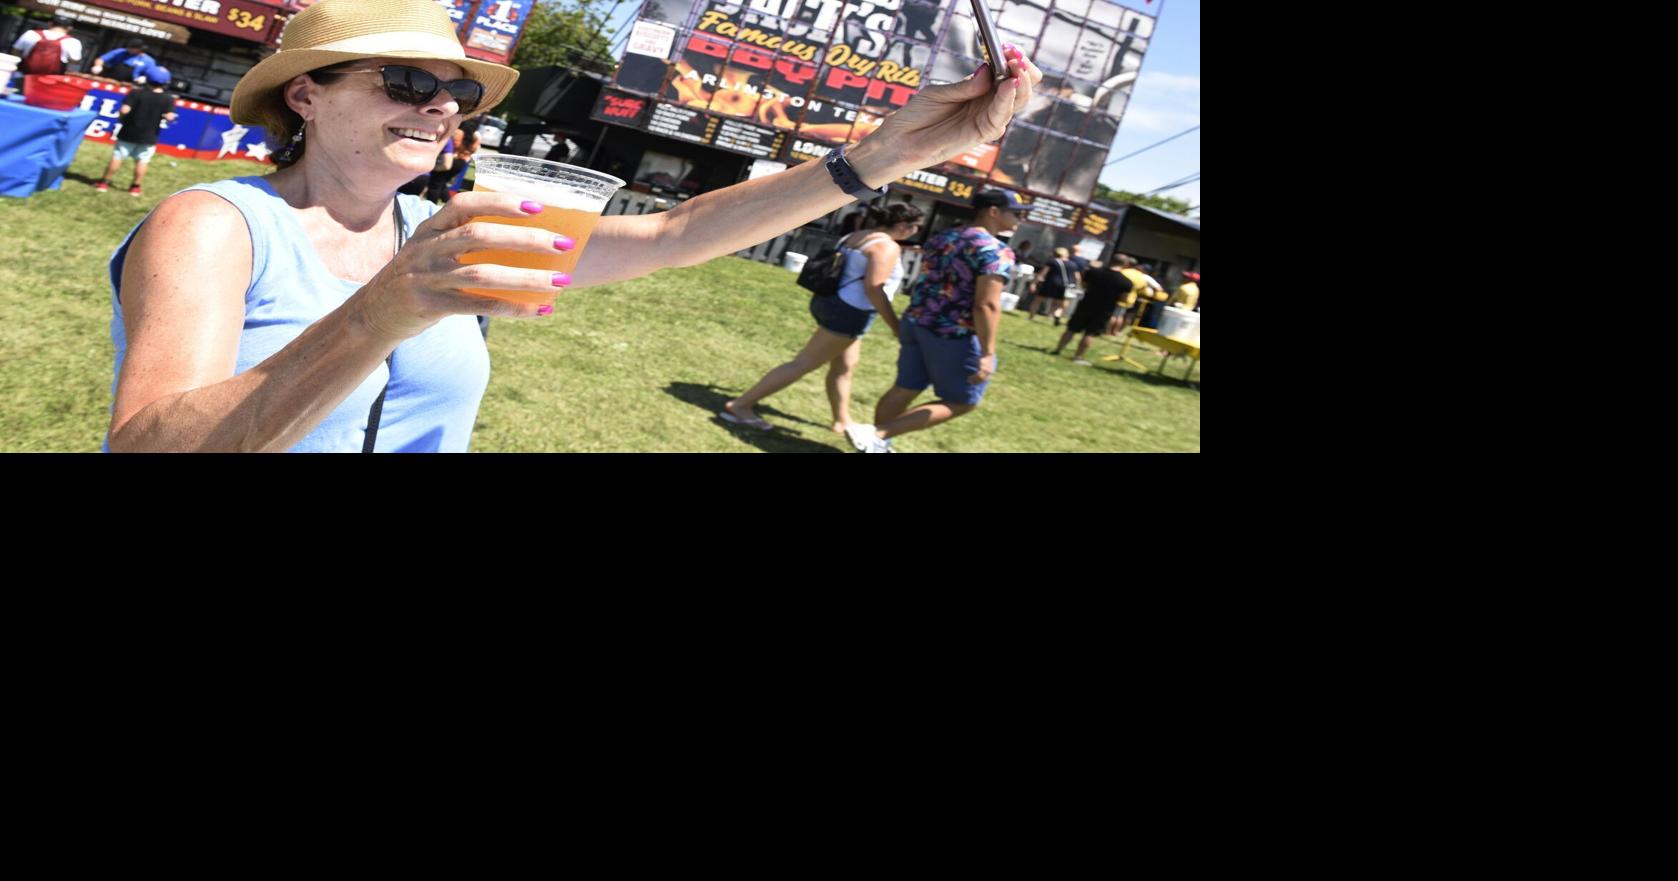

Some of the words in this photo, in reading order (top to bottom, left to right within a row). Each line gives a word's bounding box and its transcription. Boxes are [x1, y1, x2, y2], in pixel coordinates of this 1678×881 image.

[227, 7, 266, 31] $34
[698, 10, 817, 61] Famous
[824, 44, 880, 76] Dry
[684, 69, 823, 113] ARLINGTON
[832, 106, 885, 127] TEXA
[824, 66, 919, 107] PIT
[904, 169, 949, 188] TTER
[948, 180, 974, 199] $34
